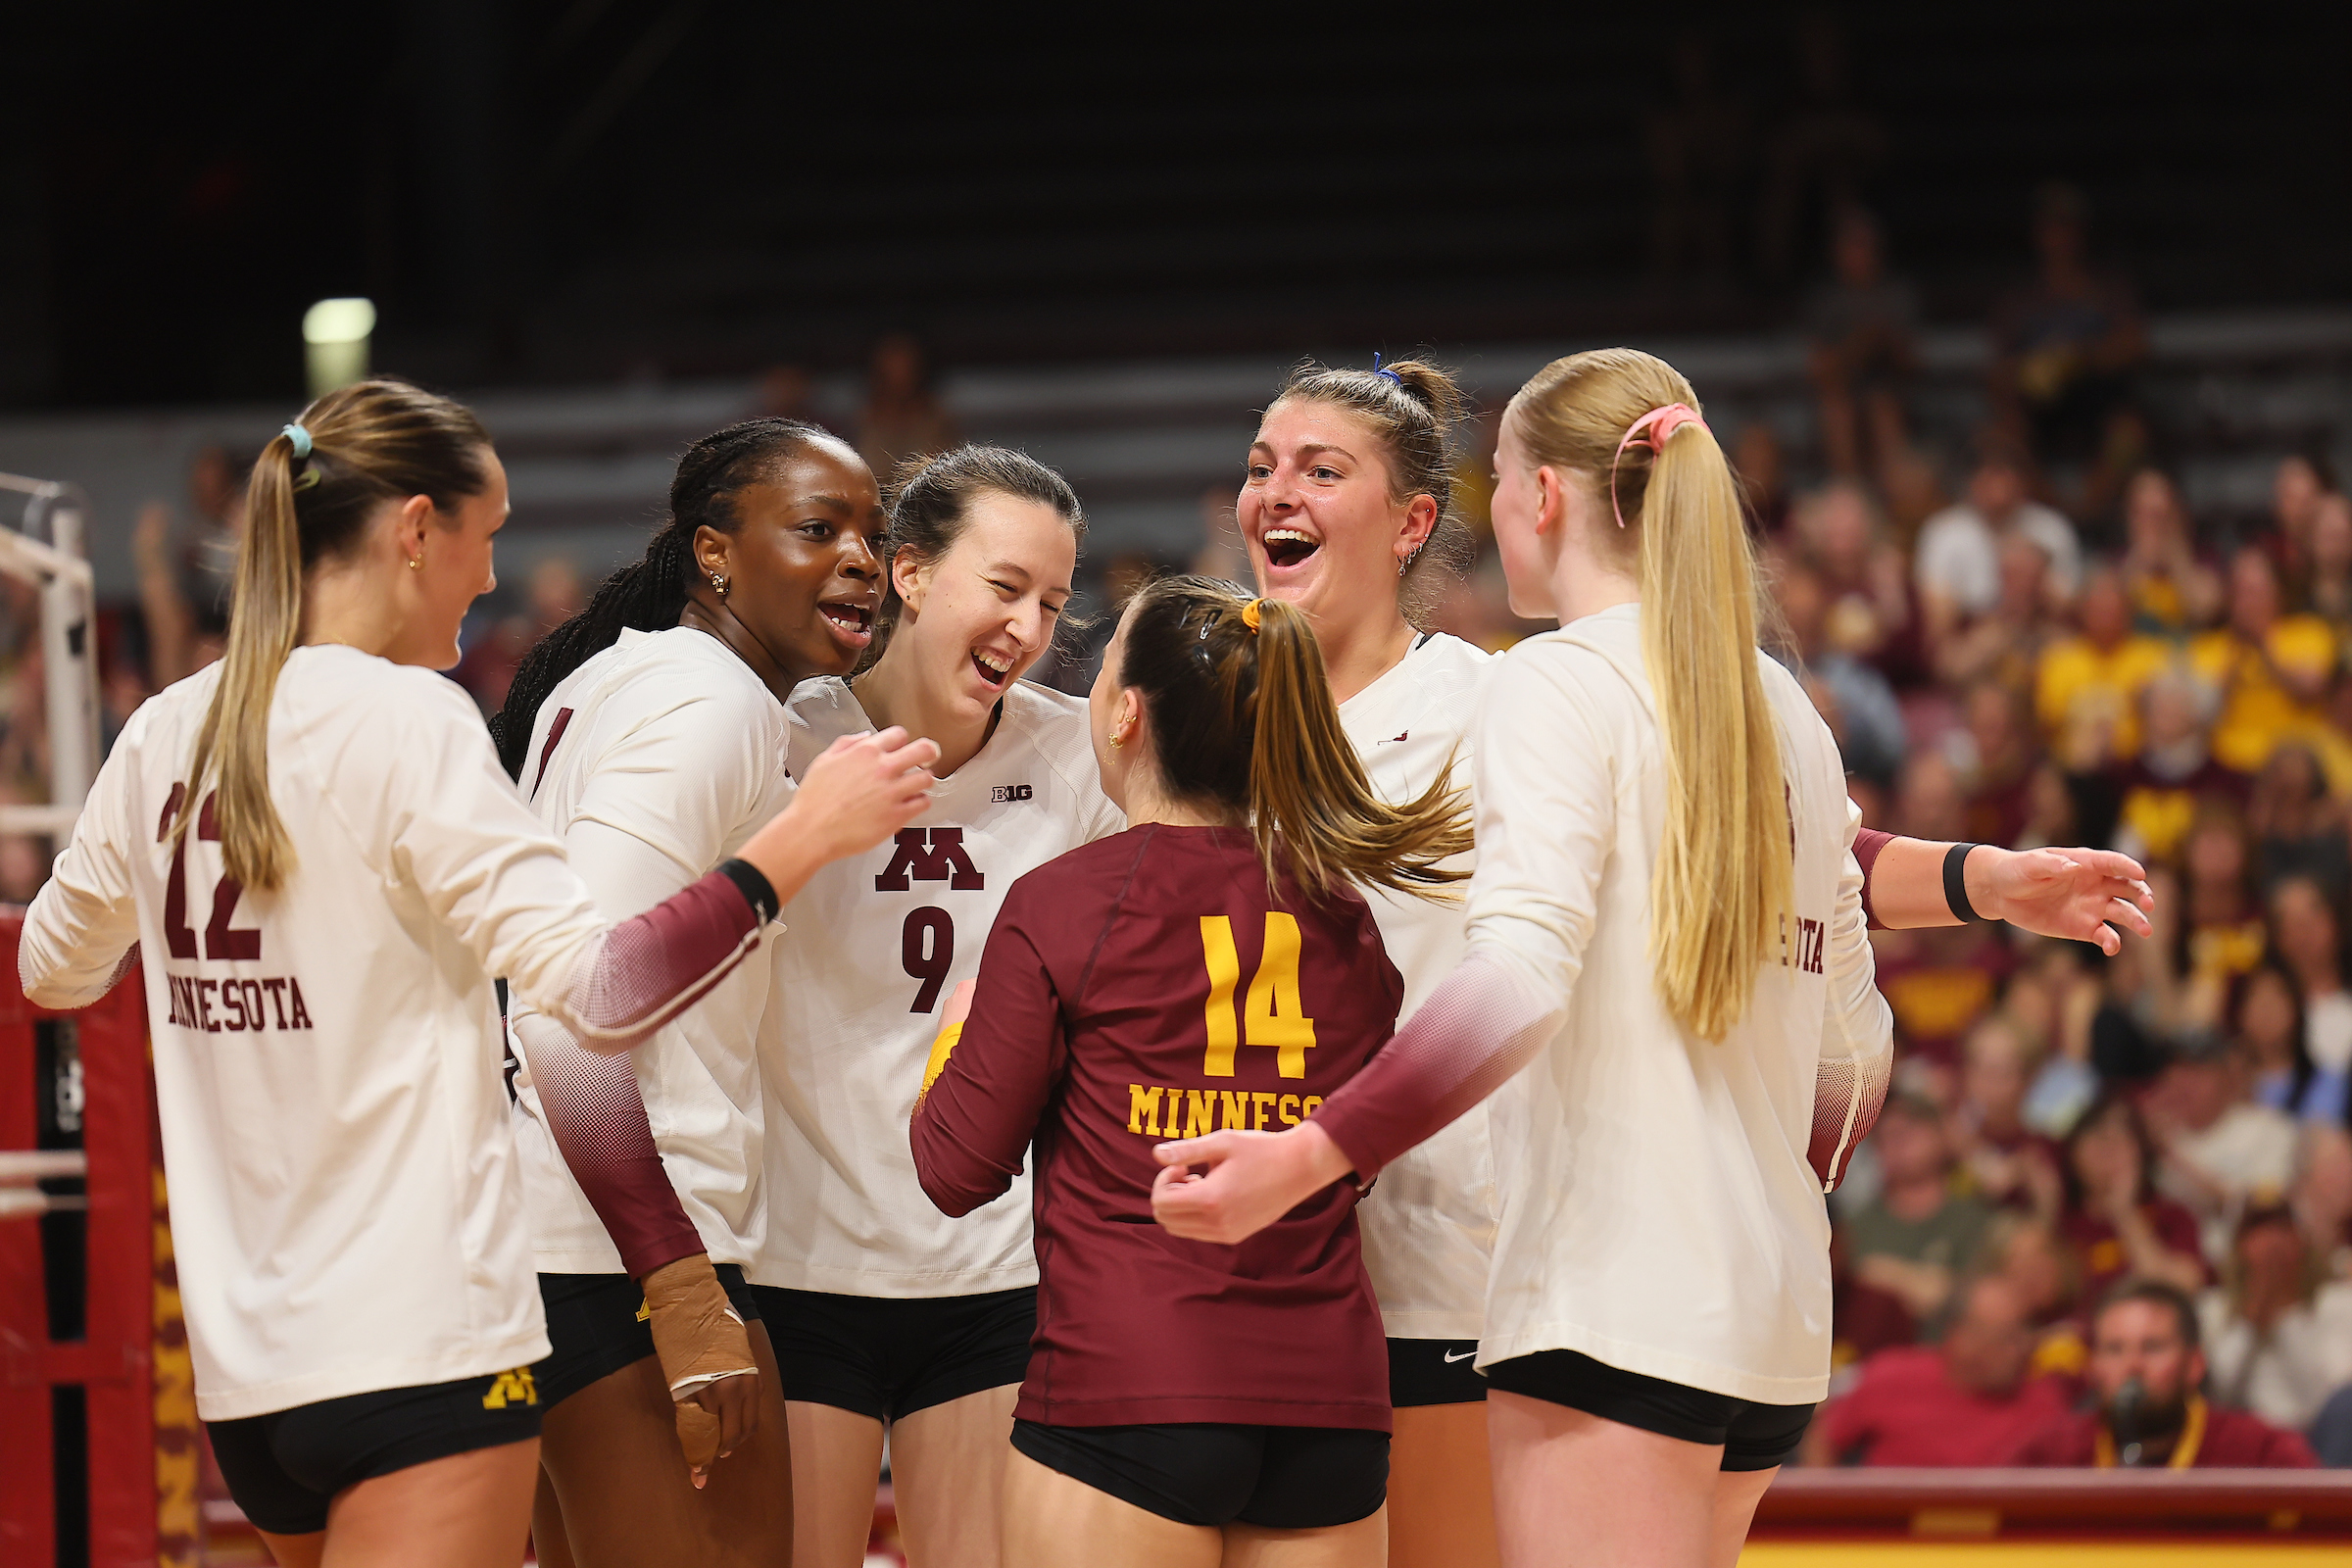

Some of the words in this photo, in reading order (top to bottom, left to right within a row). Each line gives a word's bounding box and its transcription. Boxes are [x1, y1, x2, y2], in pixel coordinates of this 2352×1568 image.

[875, 827, 985, 893] M
[902, 905, 955, 1014] 9
[1199, 910, 1317, 1080] 14
